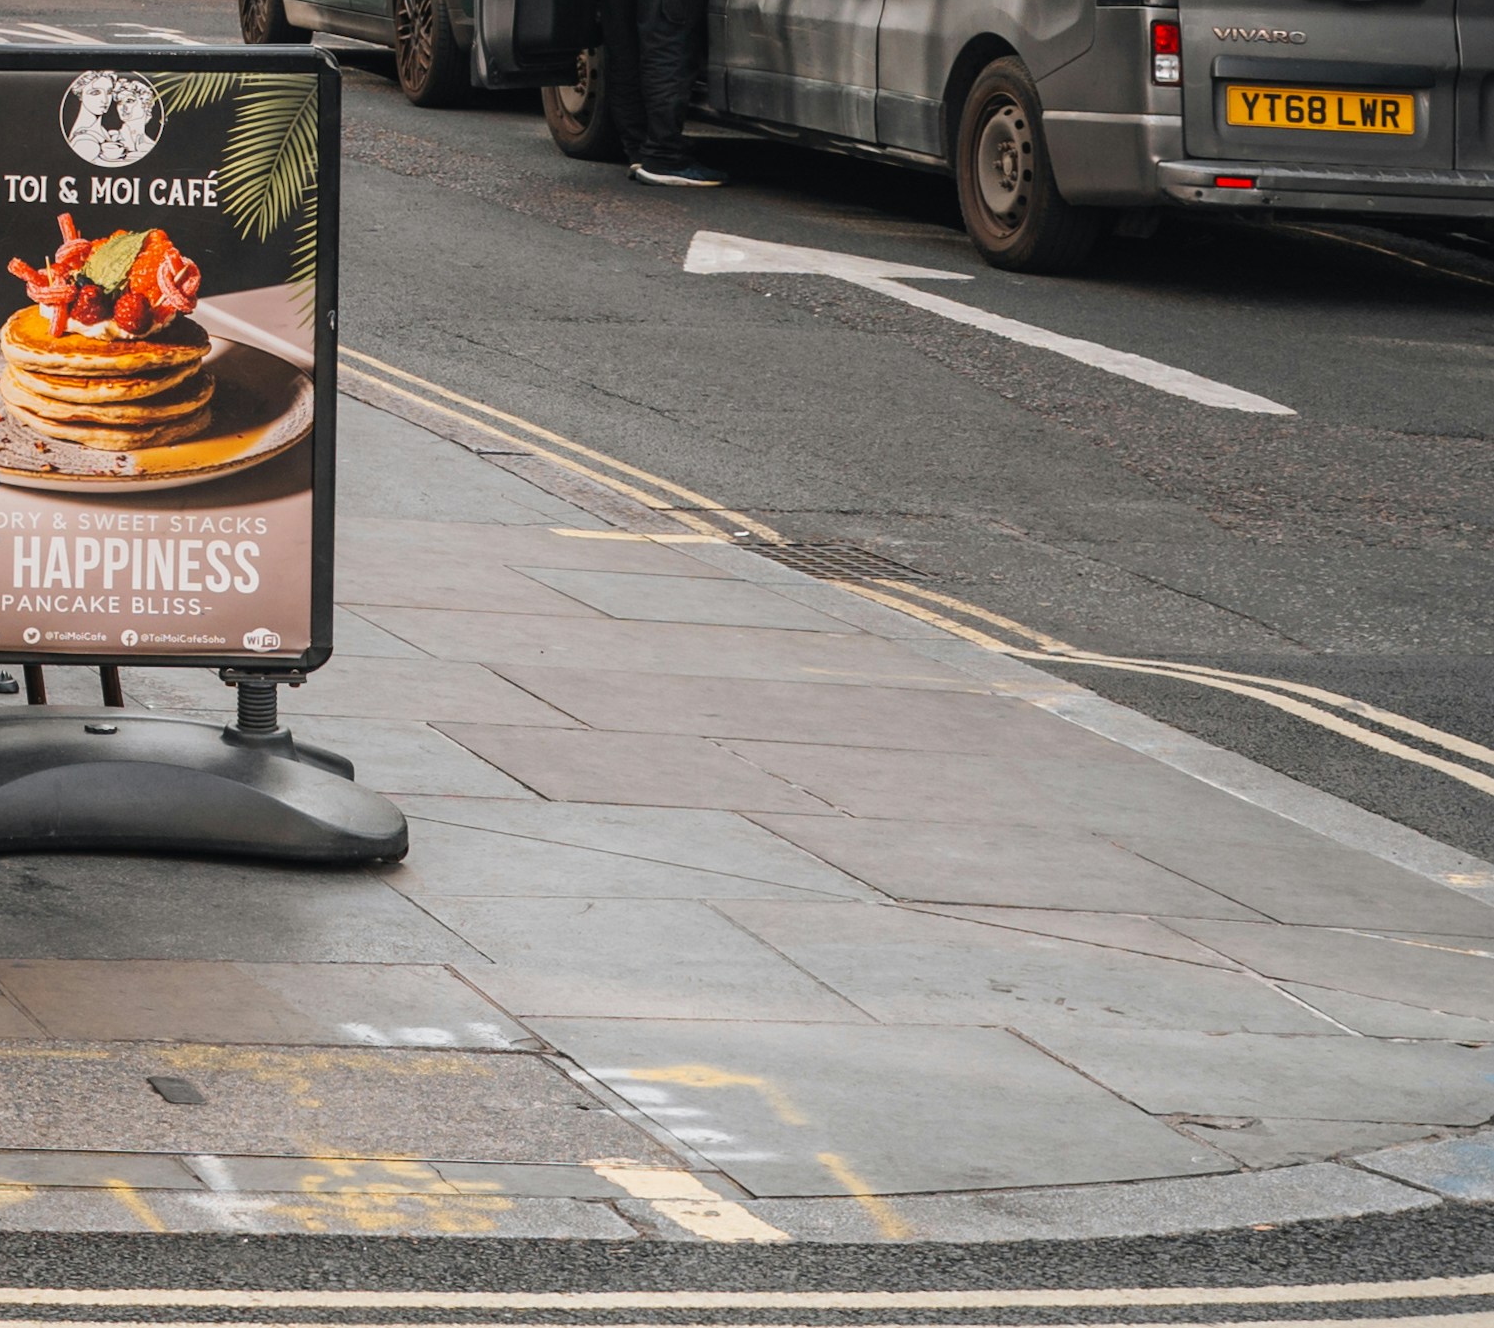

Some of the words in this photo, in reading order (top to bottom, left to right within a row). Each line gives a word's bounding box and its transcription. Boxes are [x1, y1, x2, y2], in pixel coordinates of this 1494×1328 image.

[1212, 27, 1308, 44] VIVARO
[1241, 92, 1327, 125] YT68
[1337, 96, 1401, 128] LWR
[3, 174, 48, 203] TOI
[58, 175, 80, 204] &
[90, 176, 141, 205] MOI
[149, 169, 219, 207] CAFÉ
[52, 511, 68, 530] &
[78, 512, 160, 532] SWEET
[170, 514, 268, 535] STACKS
[13, 534, 261, 594] HAPPINESS
